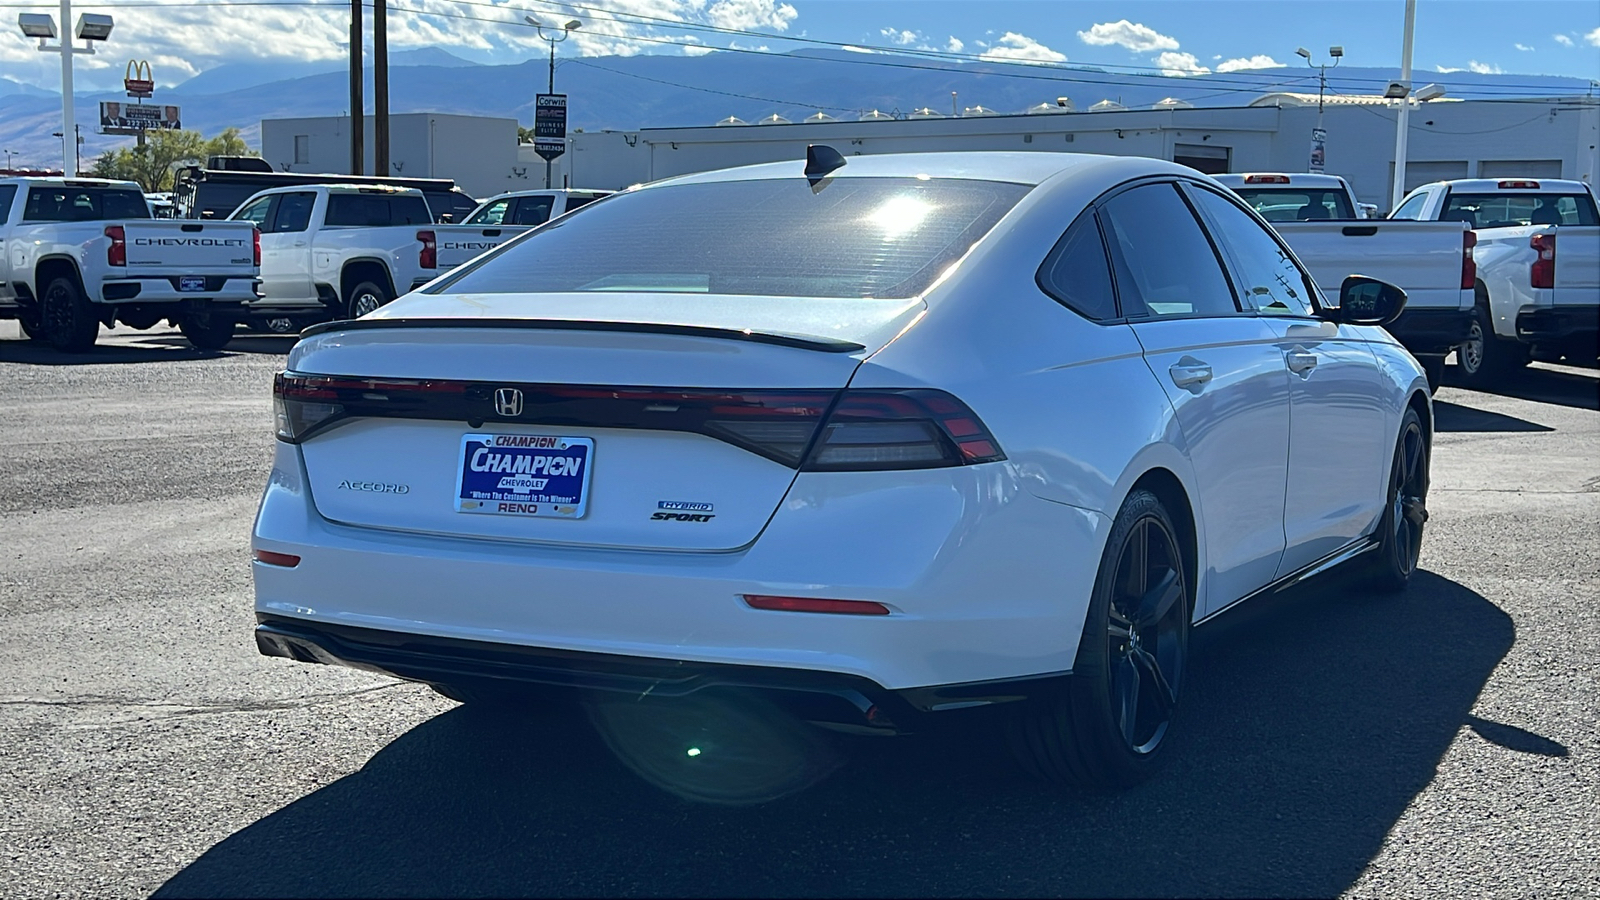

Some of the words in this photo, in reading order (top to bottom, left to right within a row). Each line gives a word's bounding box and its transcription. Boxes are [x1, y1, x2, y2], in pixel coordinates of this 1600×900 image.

[539, 97, 566, 106] Corwin
[537, 109, 565, 117] GMC
[135, 238, 245, 246] CHEVROLET
[444, 242, 501, 250] CHEVR
[495, 436, 557, 448] CHAMPION
[470, 447, 582, 477] CHAMPION
[338, 480, 409, 494] ACCORD
[500, 478, 545, 488] CHEVROLET
[492, 491, 502, 500] The
[503, 492, 531, 502] Customer
[531, 494, 538, 502] Is
[538, 494, 550, 502] The
[497, 503, 538, 514] RENO
[662, 501, 711, 510] HYBRID
[650, 512, 716, 522] SPORT
